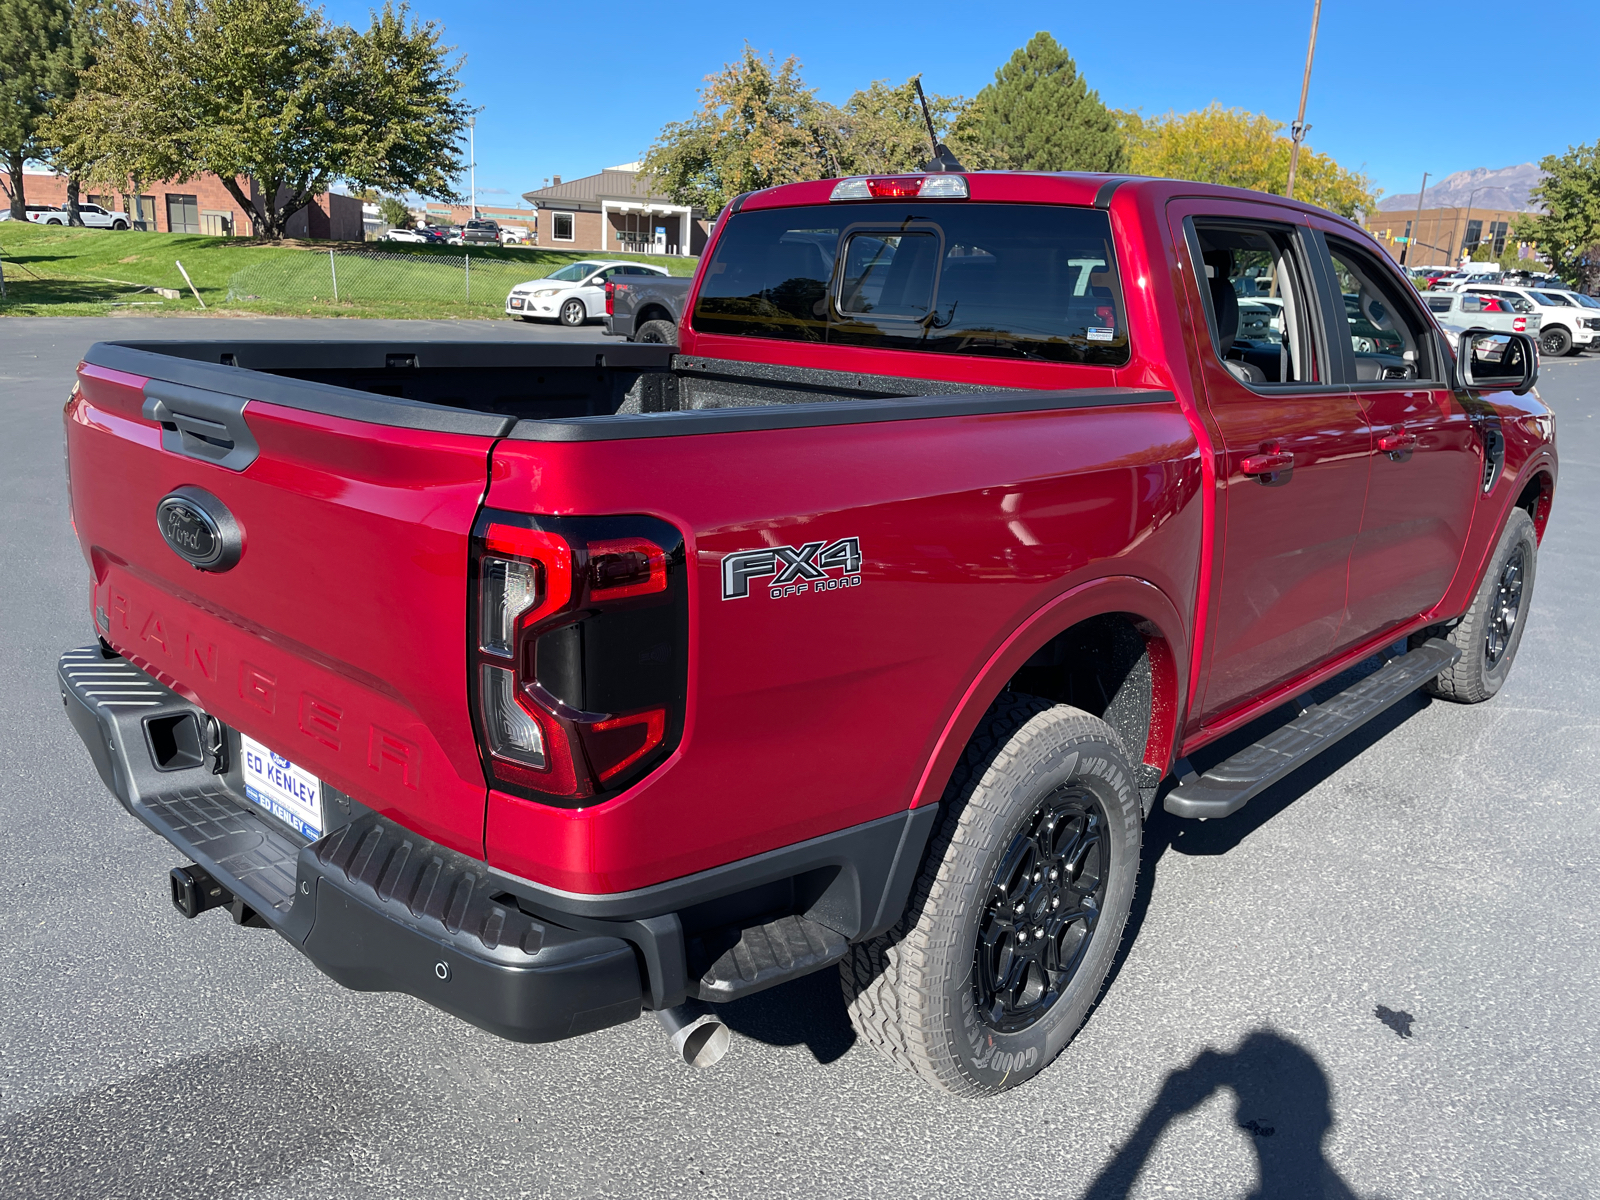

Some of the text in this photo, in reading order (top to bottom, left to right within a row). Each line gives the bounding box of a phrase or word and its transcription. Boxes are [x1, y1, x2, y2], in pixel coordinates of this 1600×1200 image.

[167, 510, 201, 550] Ford
[721, 536, 863, 601] FX4
[770, 575, 861, 599] OFF ROAD
[110, 585, 421, 791] RANGER
[247, 751, 262, 774] ED
[267, 762, 315, 807] KENLEY
[1079, 757, 1138, 848] WRANGLER
[258, 794, 272, 812] ED
[272, 803, 304, 833] KENLEY
[962, 986, 1038, 1072] GOODYEAR
